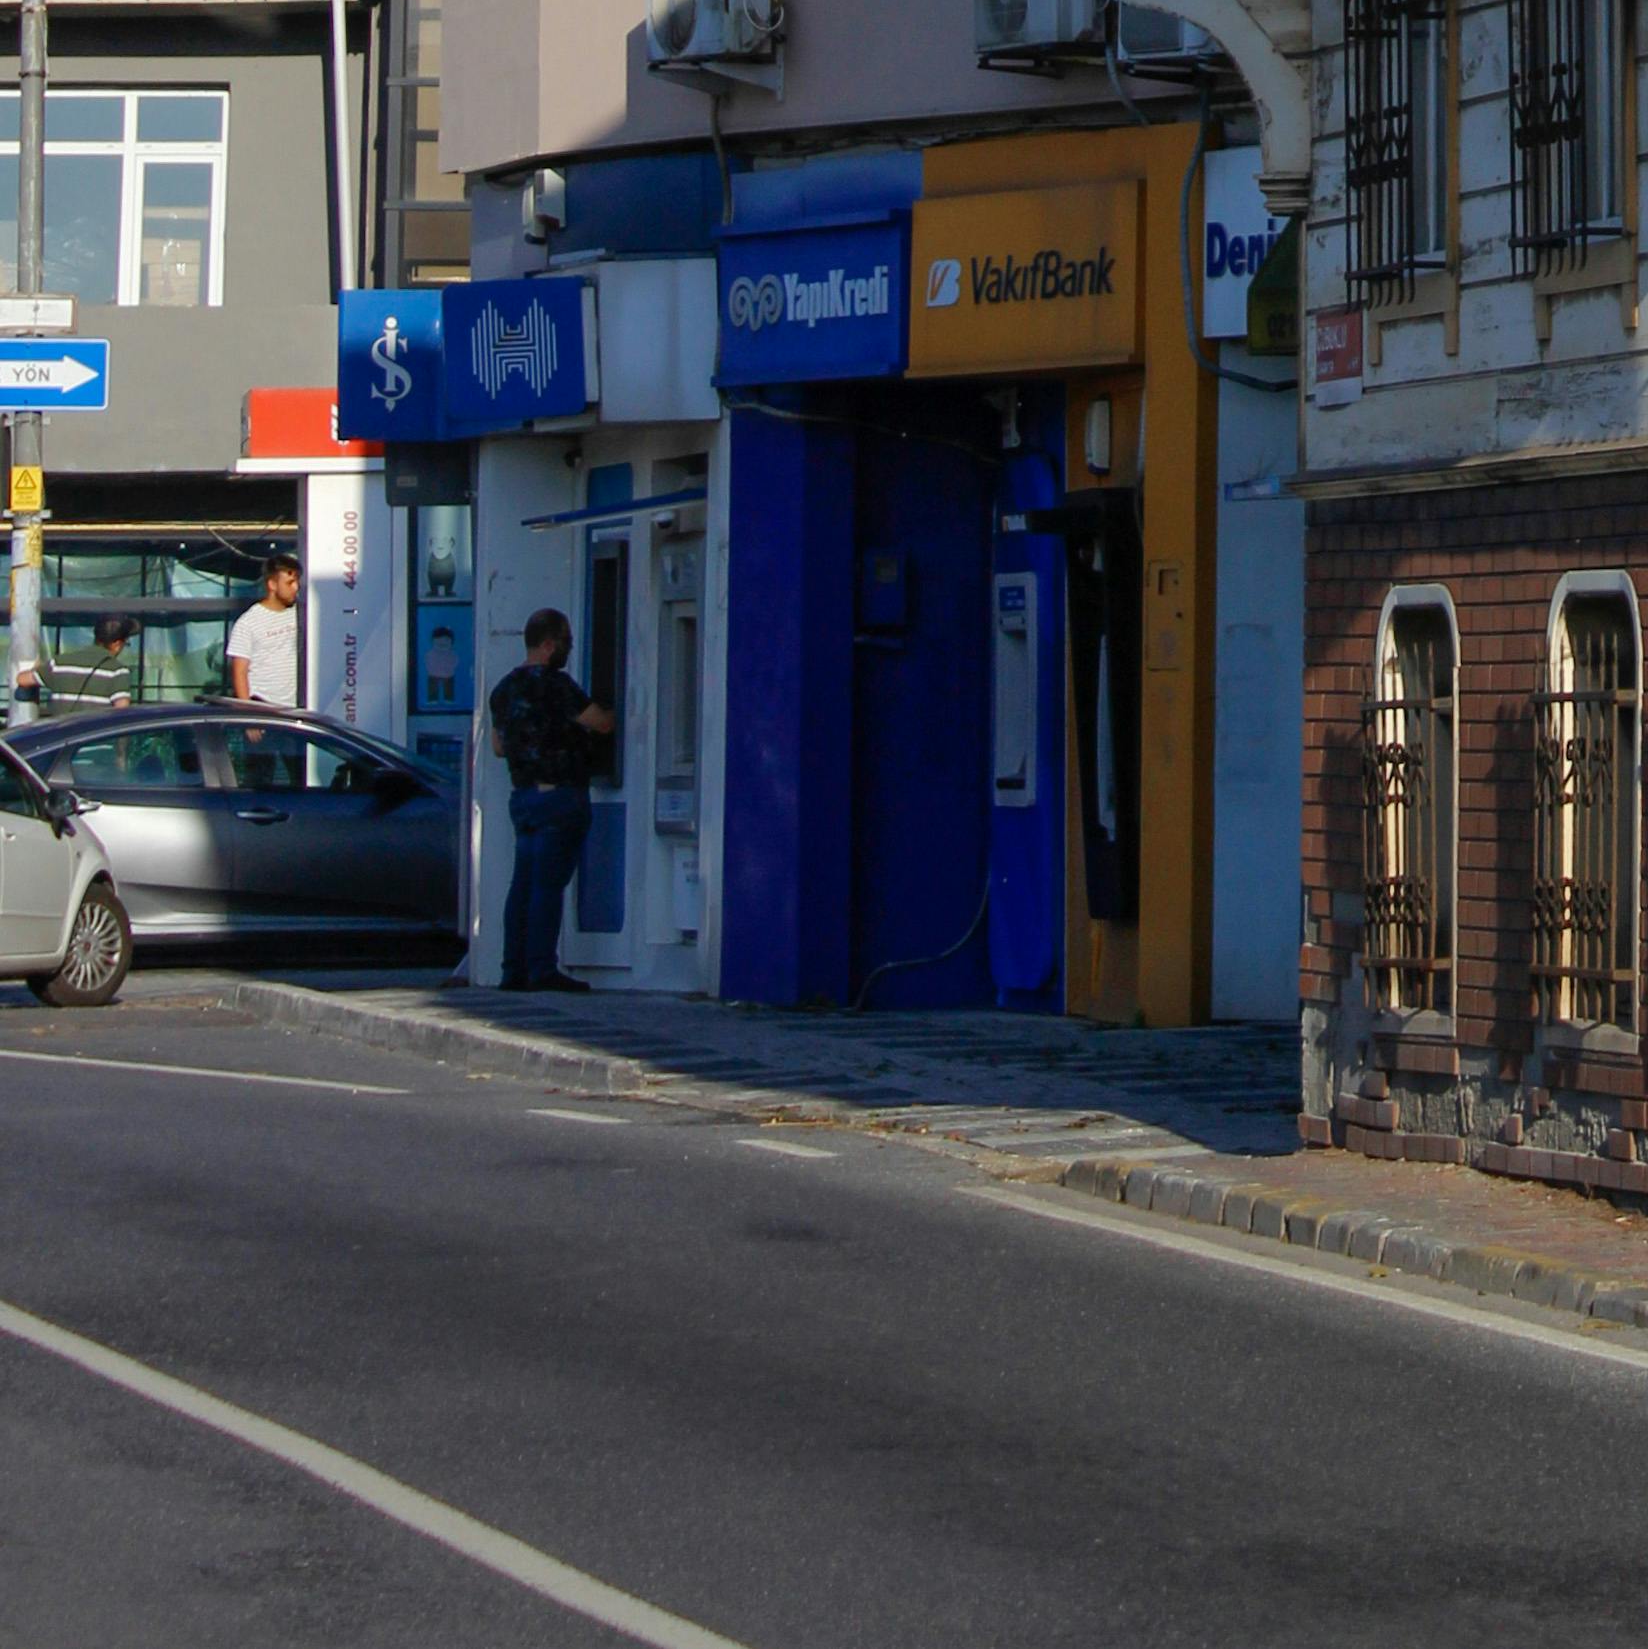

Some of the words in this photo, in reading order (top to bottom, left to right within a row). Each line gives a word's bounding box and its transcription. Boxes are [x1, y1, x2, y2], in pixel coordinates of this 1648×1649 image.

[1206, 217, 1281, 278] Deni
[970, 248, 1116, 304] VakıfBank
[783, 265, 889, 327] YapıKredi
[12, 363, 50, 382] YÖN
[343, 511, 358, 531] 00
[343, 535, 358, 555] 00
[343, 559, 357, 590] 444
